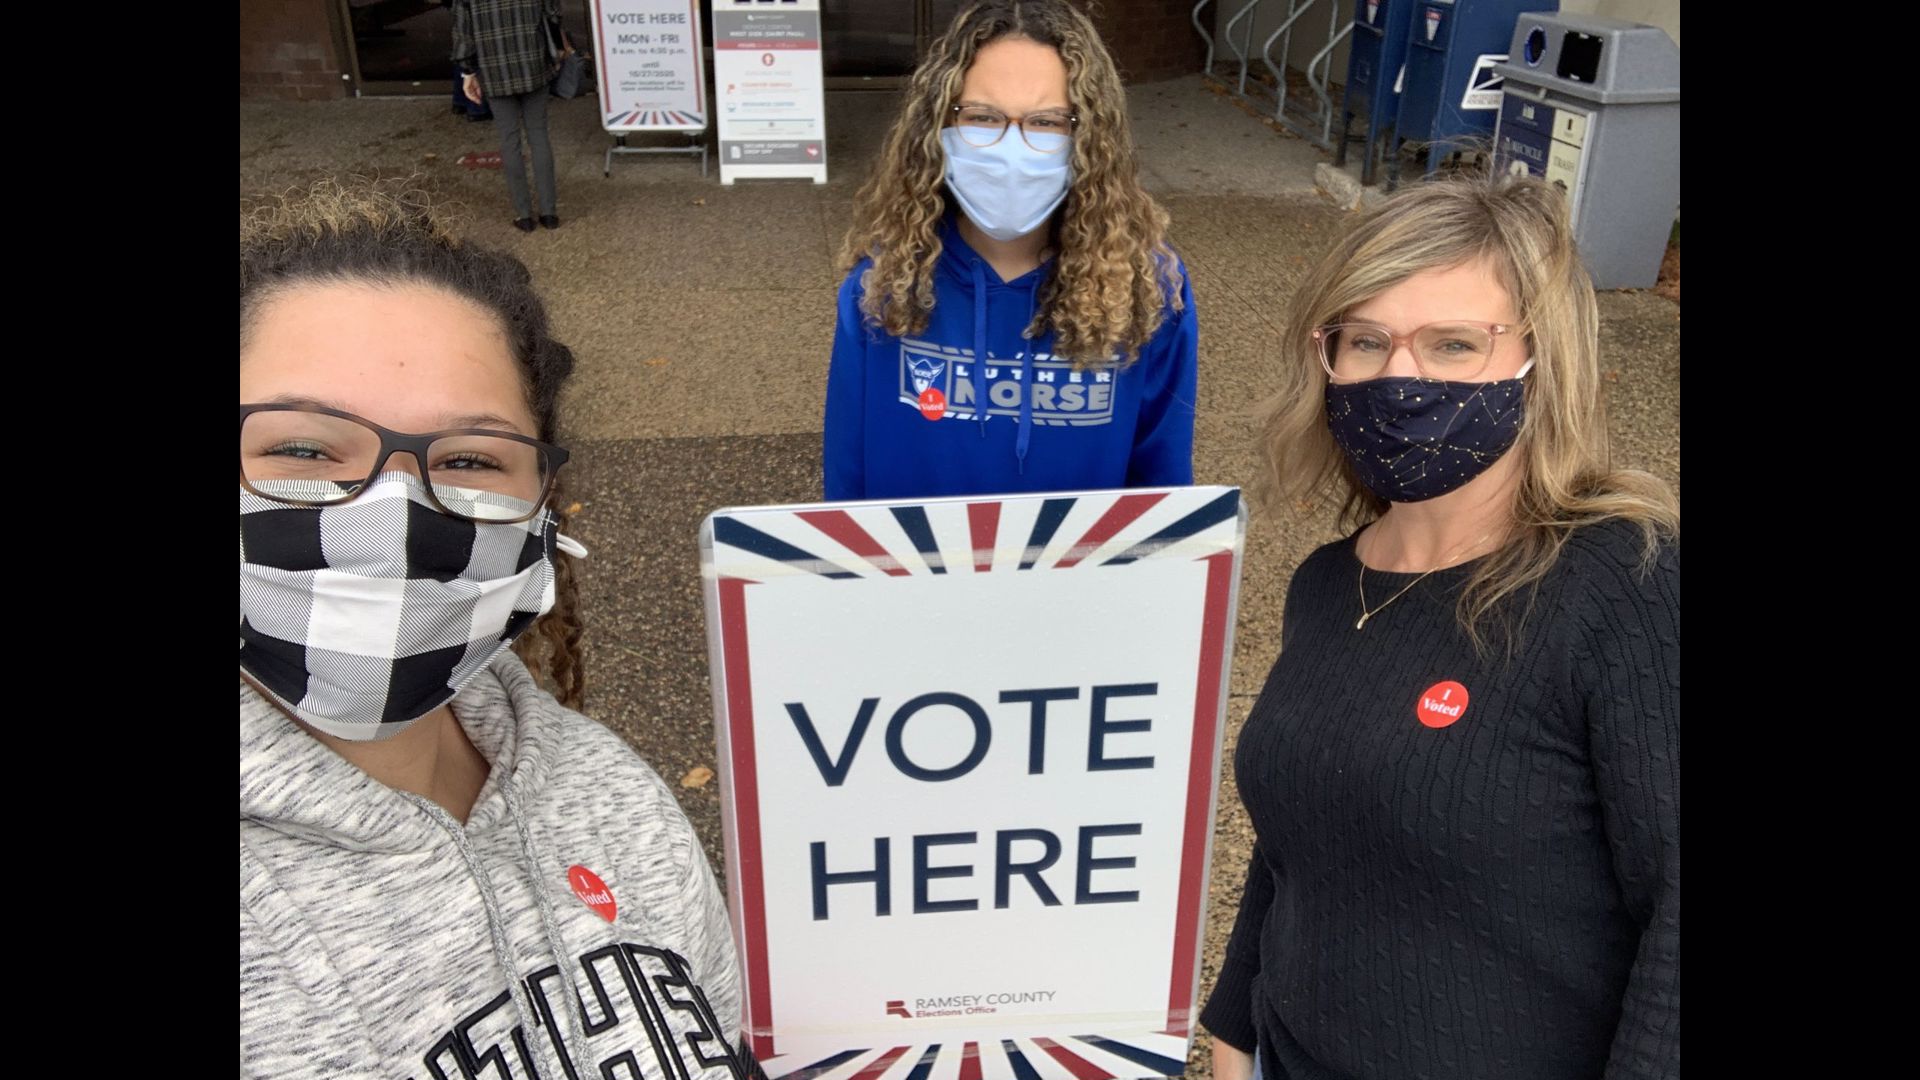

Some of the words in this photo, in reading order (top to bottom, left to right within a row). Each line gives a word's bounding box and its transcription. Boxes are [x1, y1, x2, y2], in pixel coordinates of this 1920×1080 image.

[607, 13, 645, 24] VOTE
[649, 13, 686, 24] HERE
[618, 34, 650, 44] MON
[660, 34, 680, 44] FRI
[669, 48, 687, 56] p.m.
[956, 364, 1111, 384] LUTHER
[953, 377, 1110, 412] NORSE
[921, 402, 944, 411] Voted
[1442, 688, 1452, 701] I
[1423, 697, 1461, 717] Voted
[783, 682, 1159, 788] VOTE
[809, 823, 1143, 921] HERE
[578, 874, 590, 889] I
[576, 889, 612, 905] Voted
[915, 995, 982, 1009] RAMSEY
[986, 991, 1057, 1005] COUNTY
[915, 1009, 962, 1018] Elections
[965, 1006, 997, 1015] Office
